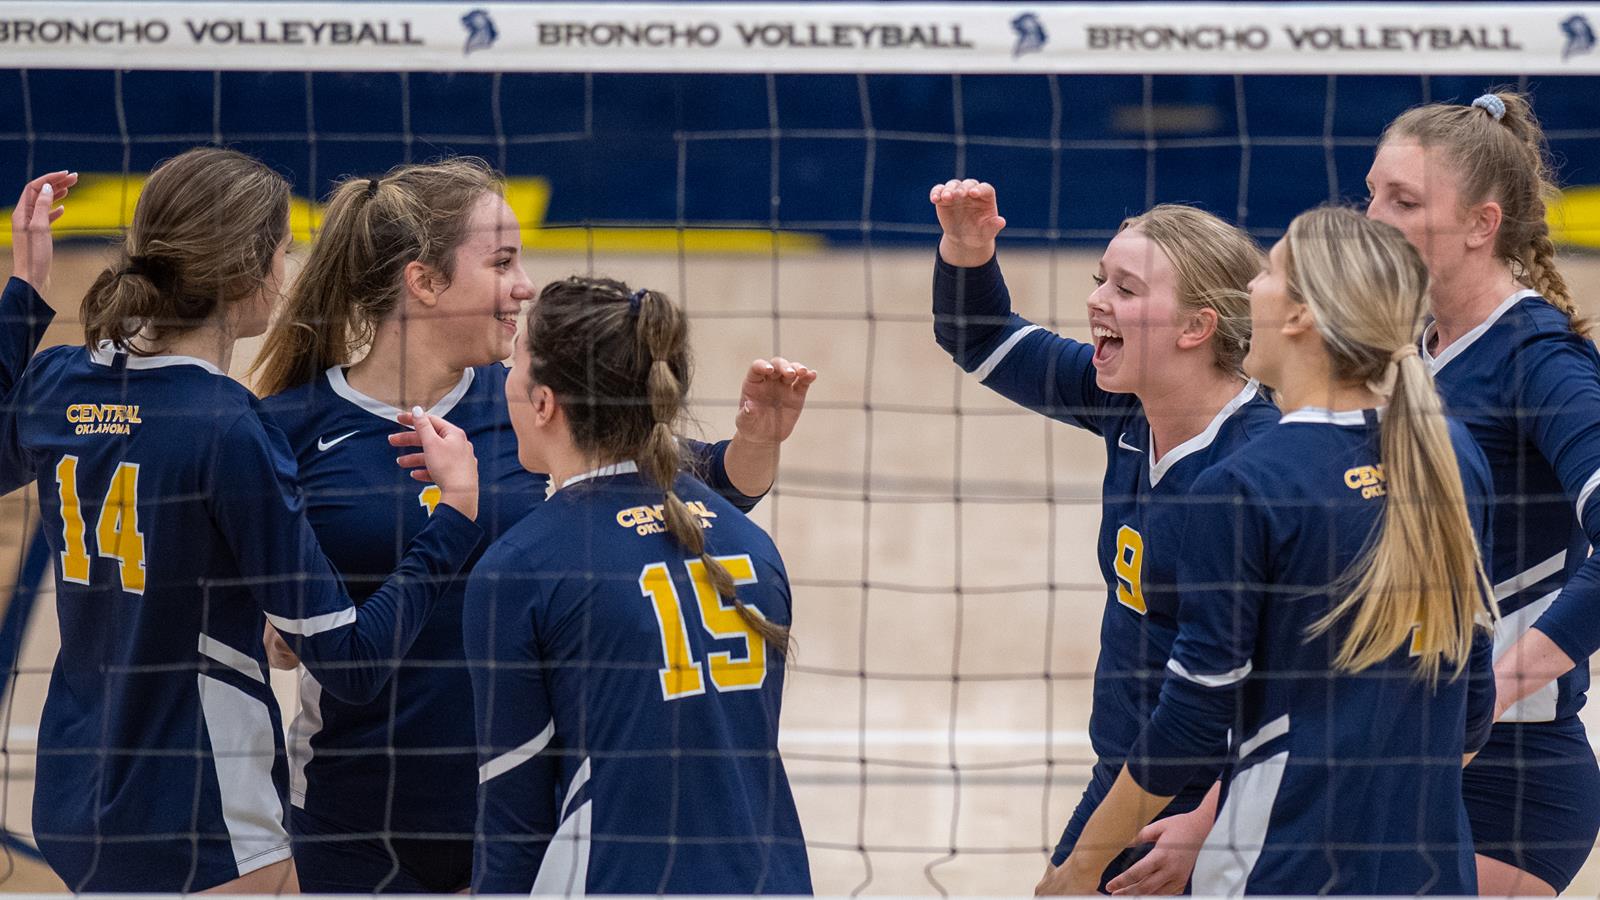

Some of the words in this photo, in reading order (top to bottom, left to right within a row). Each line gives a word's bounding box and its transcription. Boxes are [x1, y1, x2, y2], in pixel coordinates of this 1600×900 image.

[186, 20, 425, 46] VOLLEYBALL
[537, 22, 720, 48] BRONCHO
[736, 22, 974, 49] VOLLEYBALL
[1087, 24, 1270, 50] BRONCHO
[1285, 25, 1523, 51] VOLLEYBALL
[66, 403, 142, 424] CENTRAL
[75, 423, 131, 435] OKLAHOMA
[56, 454, 147, 596] 14
[616, 501, 718, 528] CENAL
[1113, 524, 1148, 616] 9
[638, 554, 768, 701] 15
